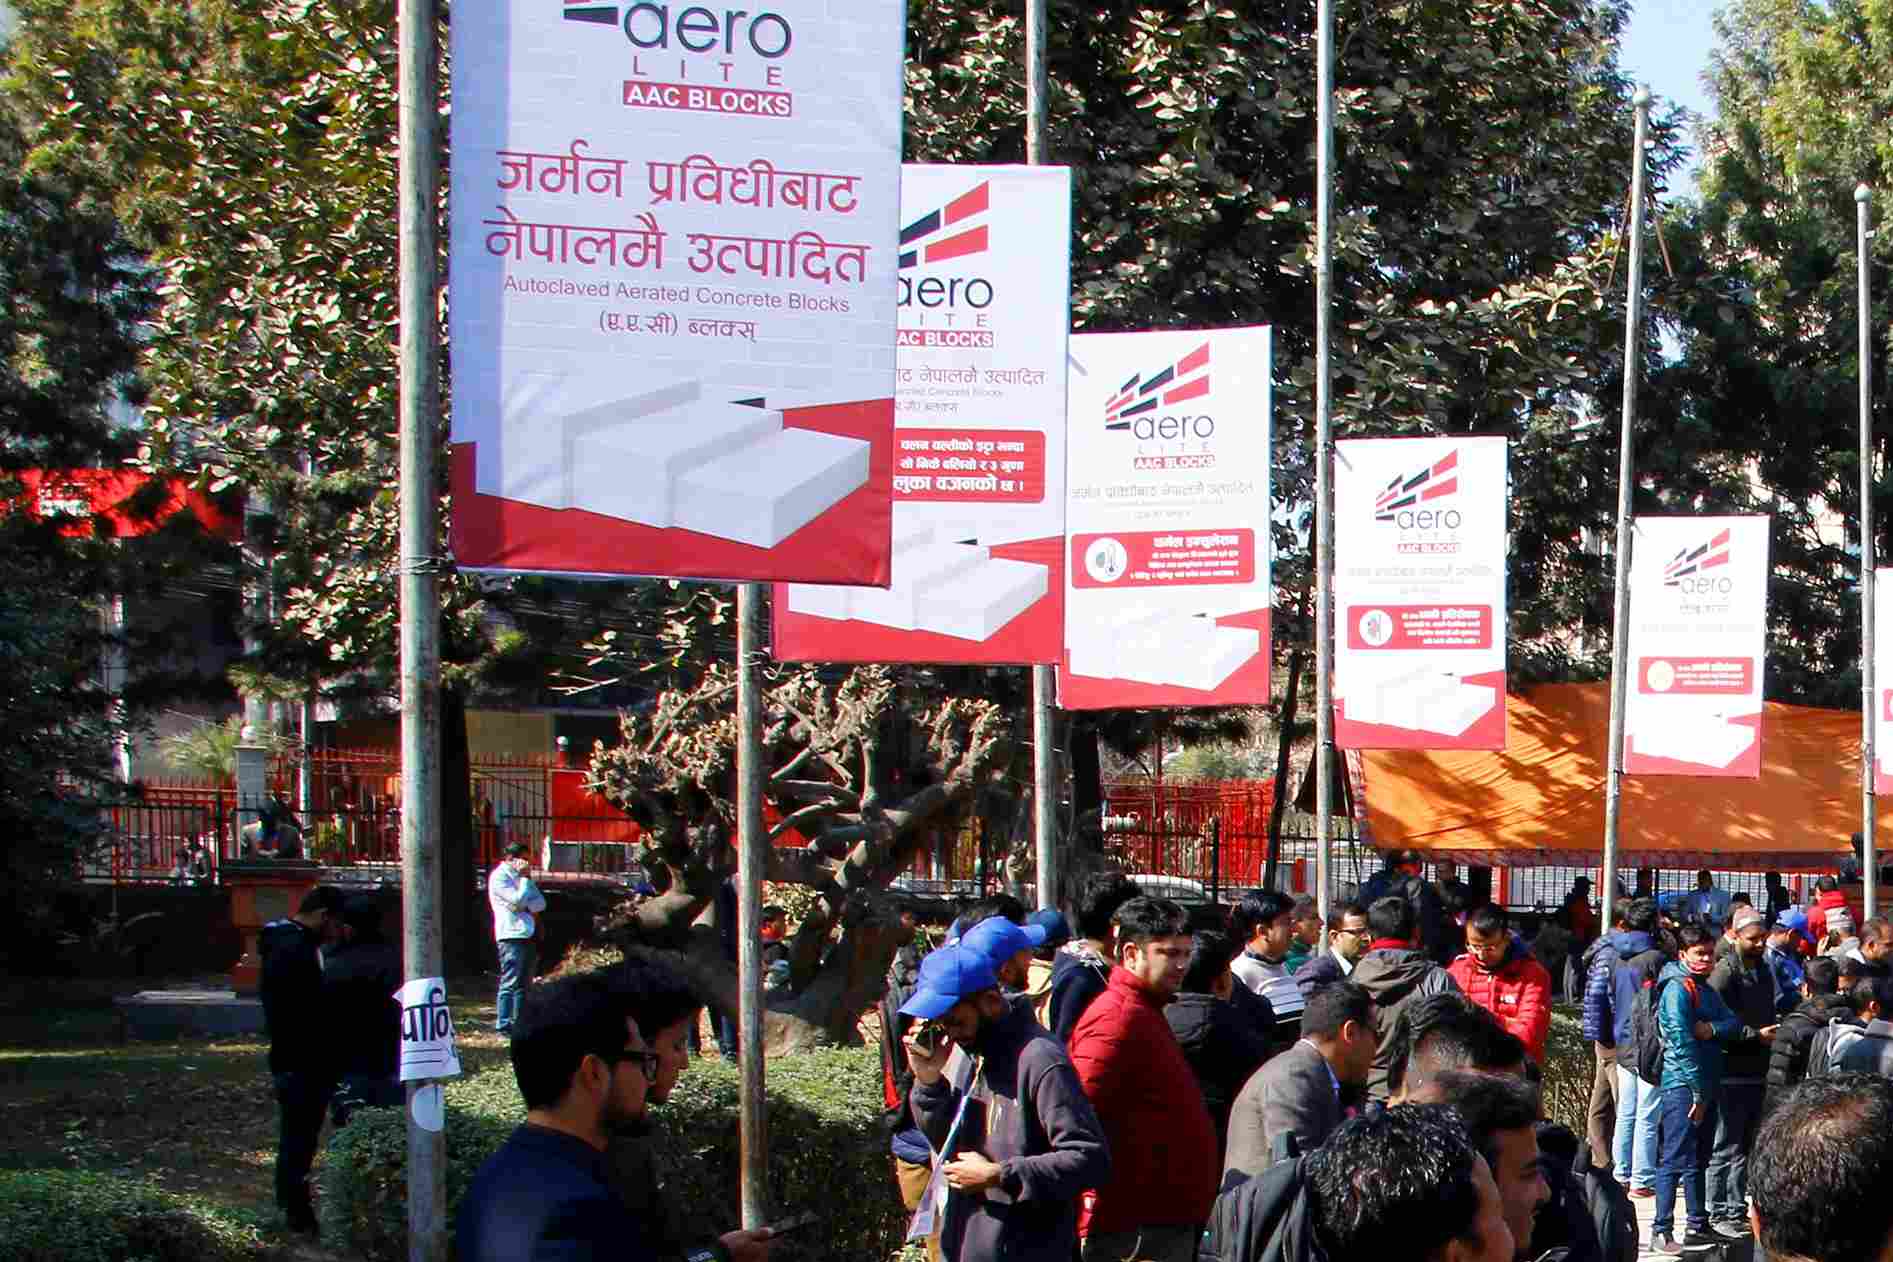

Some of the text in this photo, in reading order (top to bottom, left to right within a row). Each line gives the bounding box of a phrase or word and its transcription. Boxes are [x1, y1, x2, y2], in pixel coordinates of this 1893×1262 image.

[624, 2, 792, 58] aero
[633, 55, 782, 86] LITE
[627, 86, 790, 116] AAC BLOCKS
[496, 139, 862, 213] जर्मन प्रविधीबाट
[483, 205, 871, 285] नेपालमै उत्पादित
[504, 275, 849, 313] Autoclaved Aerated Concrete Blocks
[924, 331, 993, 346] BLOCKS
[1133, 415, 1215, 440] aero
[1397, 510, 1462, 530] aero
